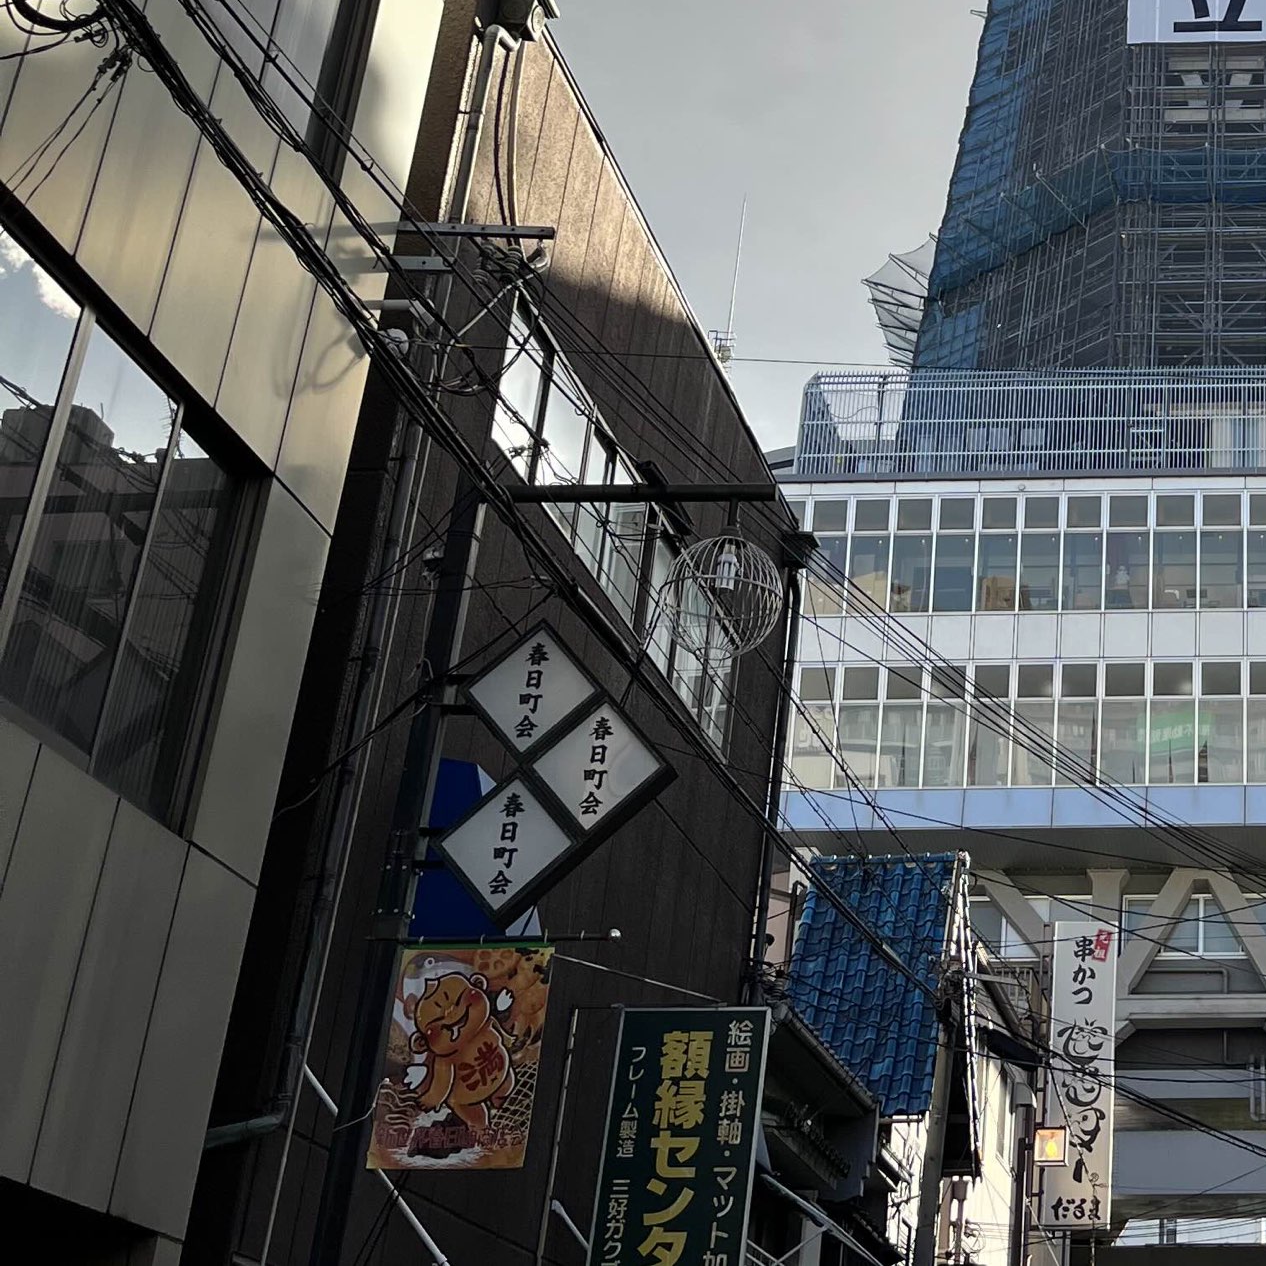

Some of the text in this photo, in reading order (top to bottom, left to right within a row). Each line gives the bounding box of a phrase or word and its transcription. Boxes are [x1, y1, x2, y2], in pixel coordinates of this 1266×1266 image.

[514, 642, 549, 739] 春日町会
[579, 717, 614, 815] 春日町会
[488, 792, 525, 895] 春日町会
[1072, 935, 1096, 1005] 串かつ
[600, 1046, 646, 1266] フレーム製造 三好ガク
[1051, 1195, 1101, 1221] だるま
